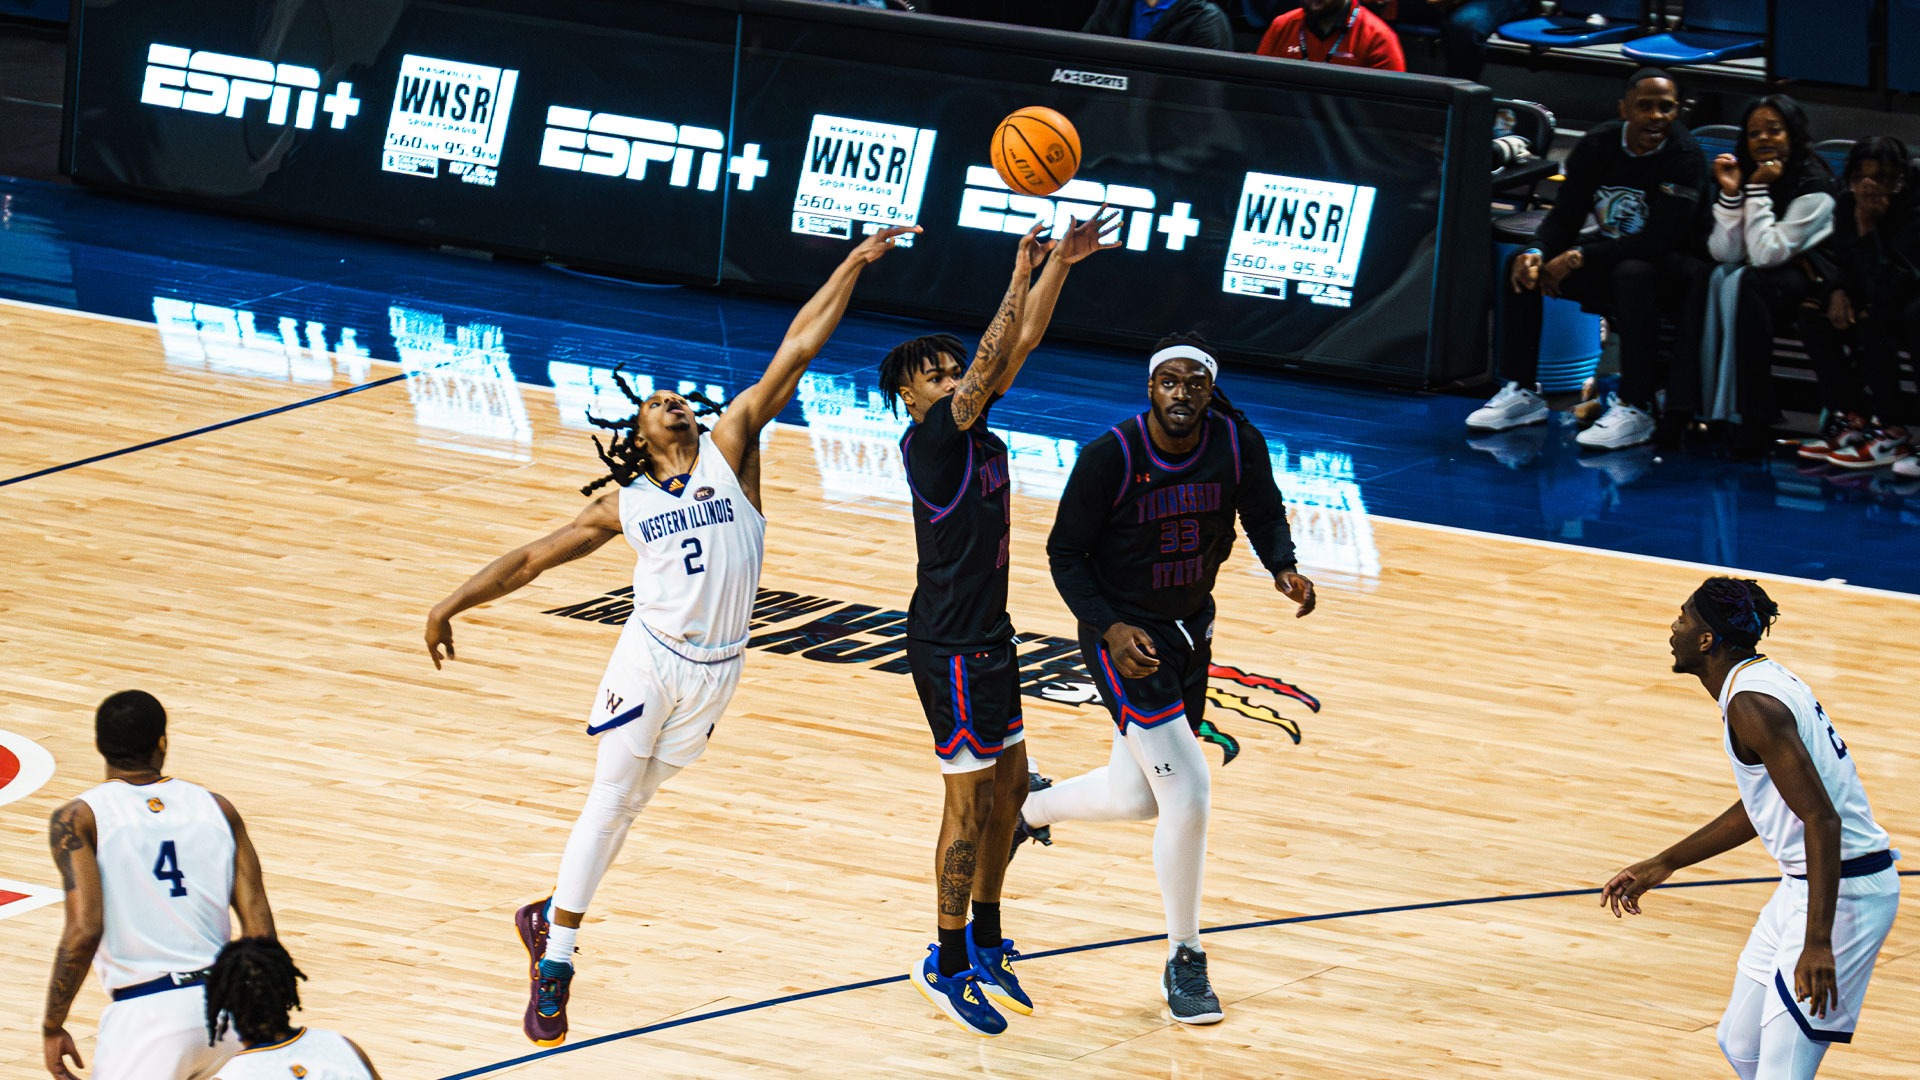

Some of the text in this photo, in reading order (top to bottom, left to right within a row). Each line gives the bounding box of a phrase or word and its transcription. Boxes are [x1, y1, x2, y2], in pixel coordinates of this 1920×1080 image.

[140, 43, 361, 130] ESPN+
[400, 75, 492, 125] WNSR
[539, 105, 769, 192] ESPN+
[810, 135, 907, 185] WNSR
[1243, 193, 1344, 243] WNSR
[638, 498, 735, 543] WESTERN ILLINOIS
[1160, 518, 1200, 553] 33
[681, 537, 705, 576] 2
[152, 840, 187, 897] 4
